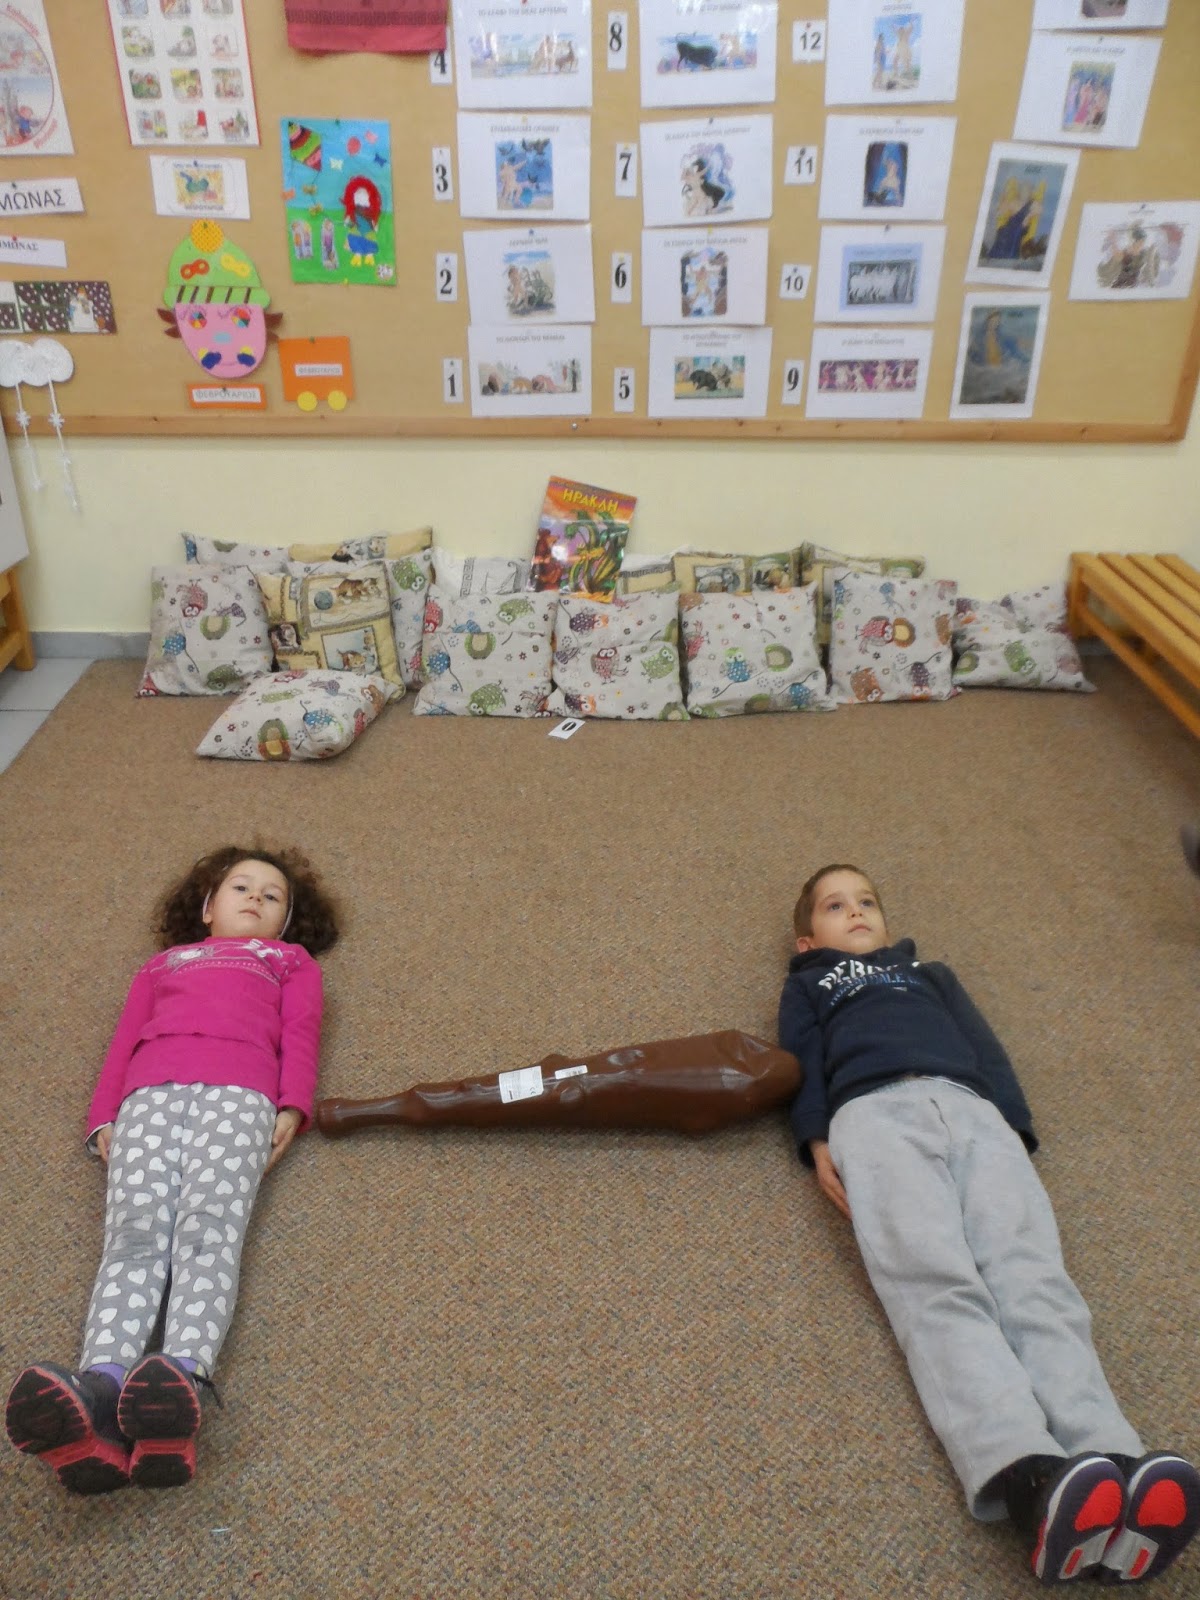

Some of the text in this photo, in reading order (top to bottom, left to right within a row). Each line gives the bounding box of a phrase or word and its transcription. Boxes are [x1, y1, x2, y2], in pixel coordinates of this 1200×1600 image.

[609, 21, 623, 52] 8
[799, 31, 822, 50] 12
[433, 51, 447, 74] 4
[619, 152, 632, 182] 7
[794, 156, 813, 175] 11
[435, 164, 449, 193] 3
[439, 269, 453, 295] 2
[614, 262, 627, 289] 6
[784, 275, 804, 292] 10
[447, 373, 456, 397] 1
[618, 375, 630, 400] 5
[787, 367, 799, 391] 9
[562, 488, 619, 514] ΗΡΑΚΛΗ
